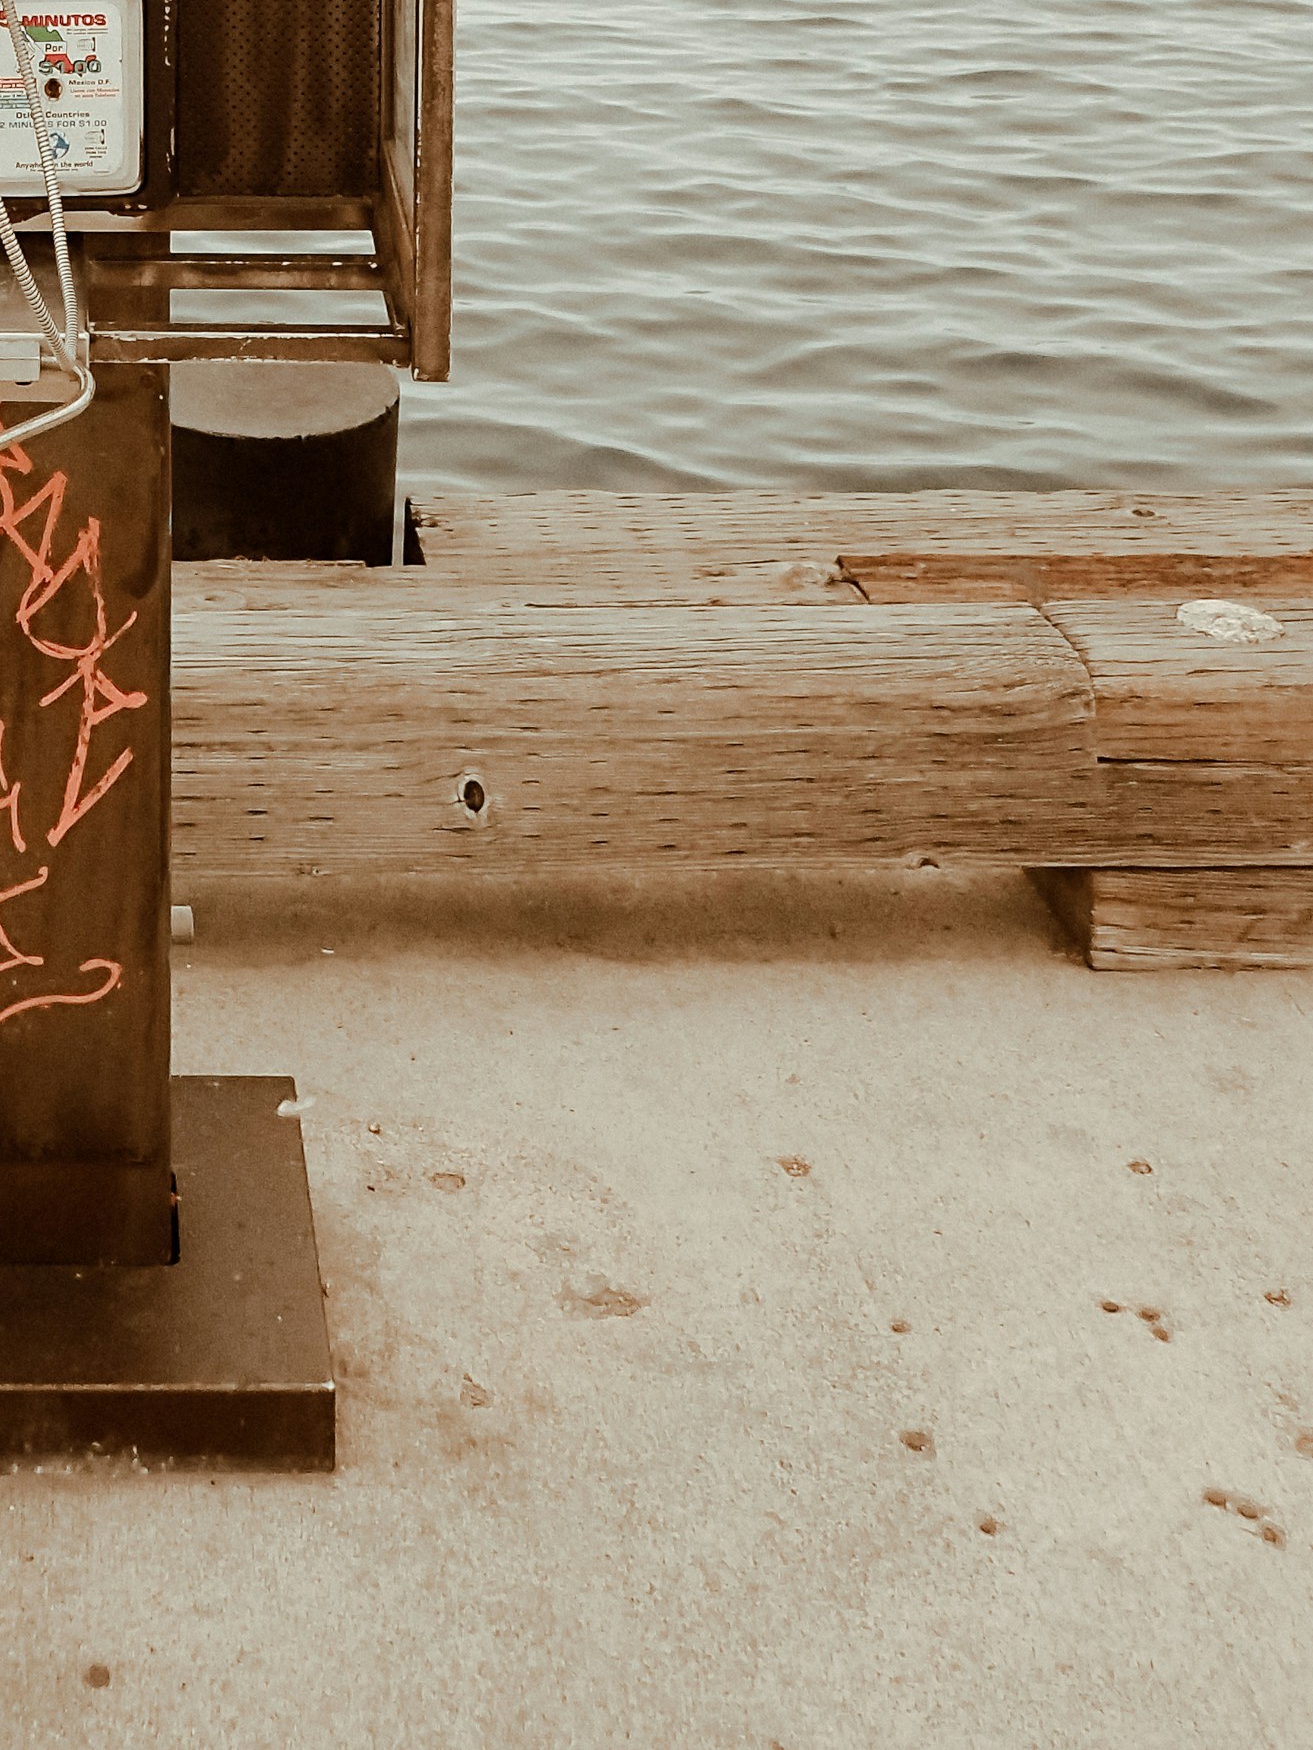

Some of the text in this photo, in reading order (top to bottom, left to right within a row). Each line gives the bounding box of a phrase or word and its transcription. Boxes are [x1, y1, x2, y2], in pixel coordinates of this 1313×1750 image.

[22, 13, 106, 27] MINUTOS
[45, 43, 63, 52] Por
[45, 111, 90, 119] Countries
[0, 121, 6, 129] 2
[78, 119, 107, 127] $1.00
